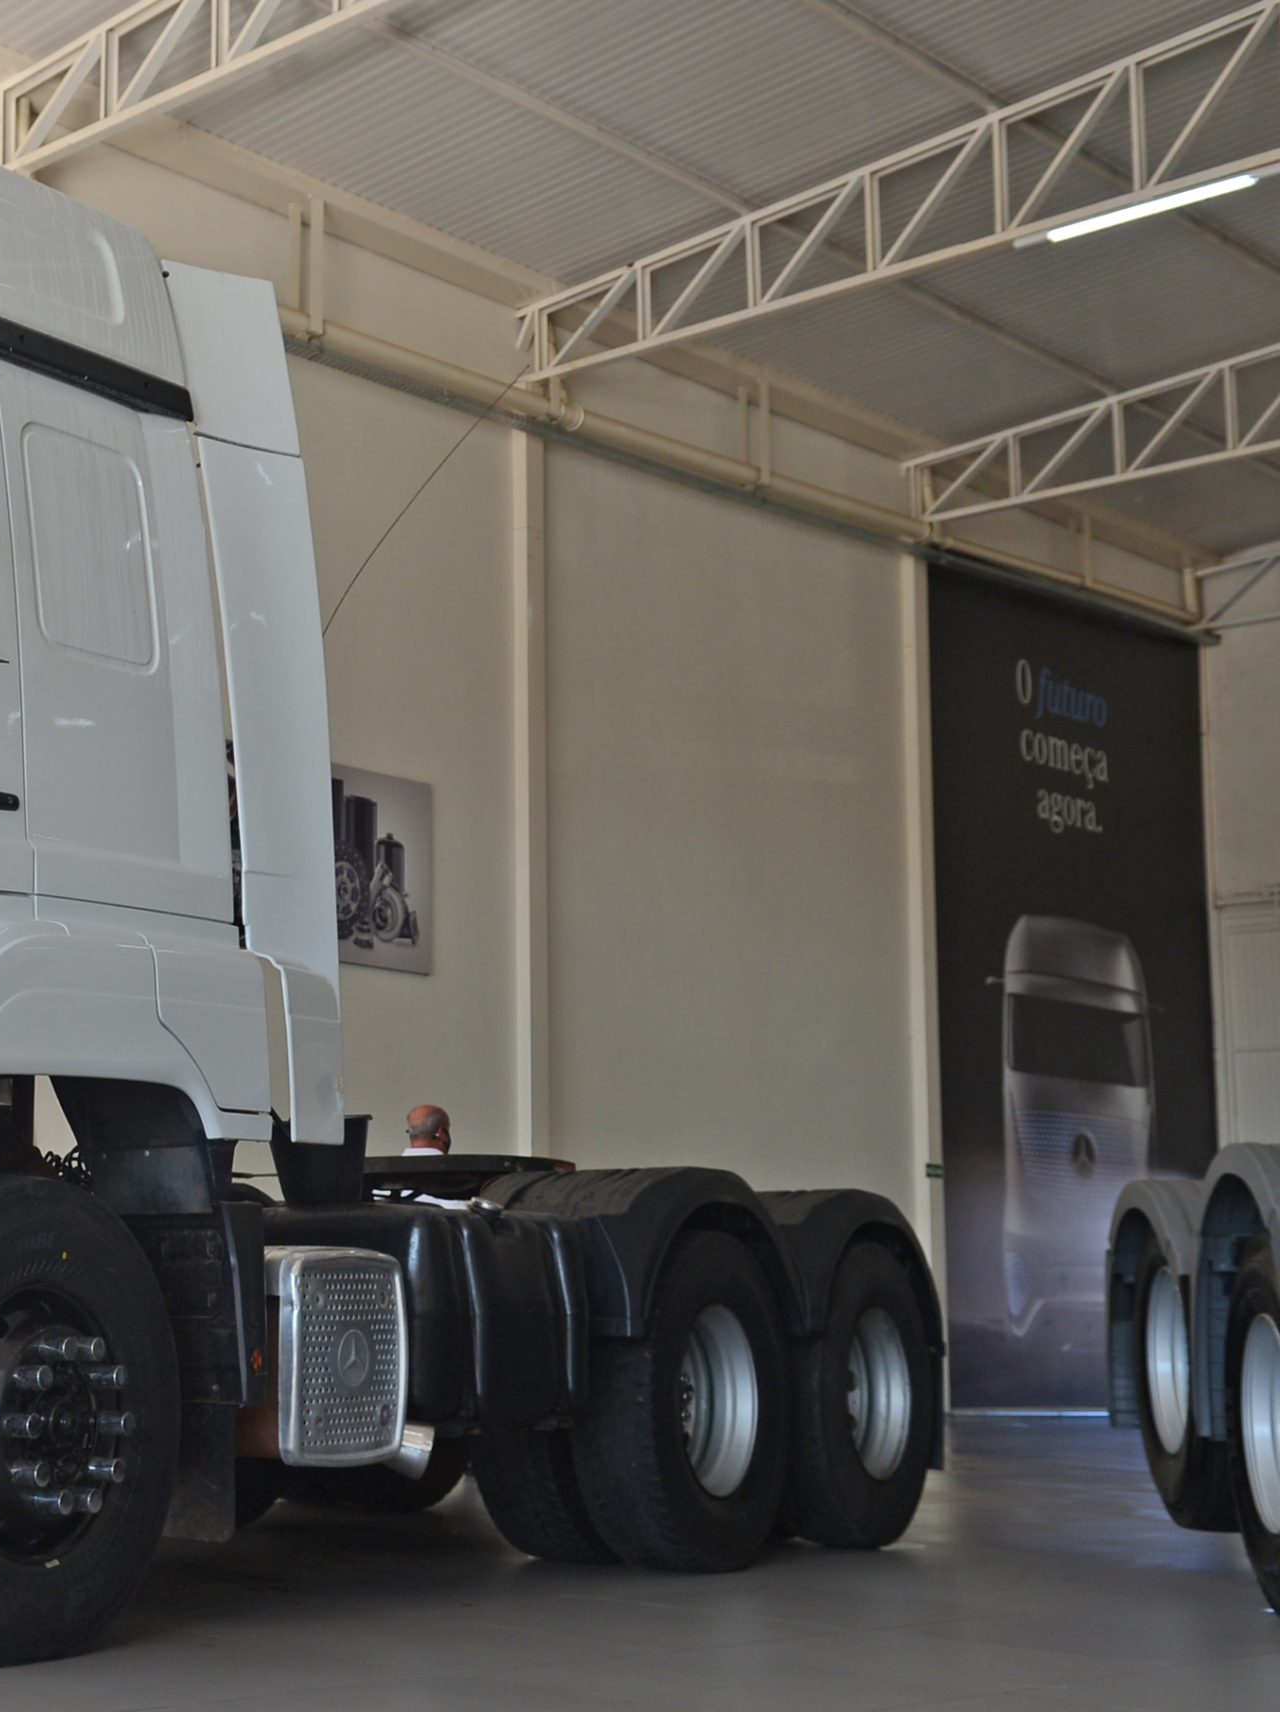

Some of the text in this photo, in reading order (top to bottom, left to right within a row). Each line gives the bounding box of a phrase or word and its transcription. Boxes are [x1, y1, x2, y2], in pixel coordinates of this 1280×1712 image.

[1015, 658, 1109, 728] O futuro
[1020, 728, 1109, 789] começa
[1036, 788, 1103, 833] agora.
